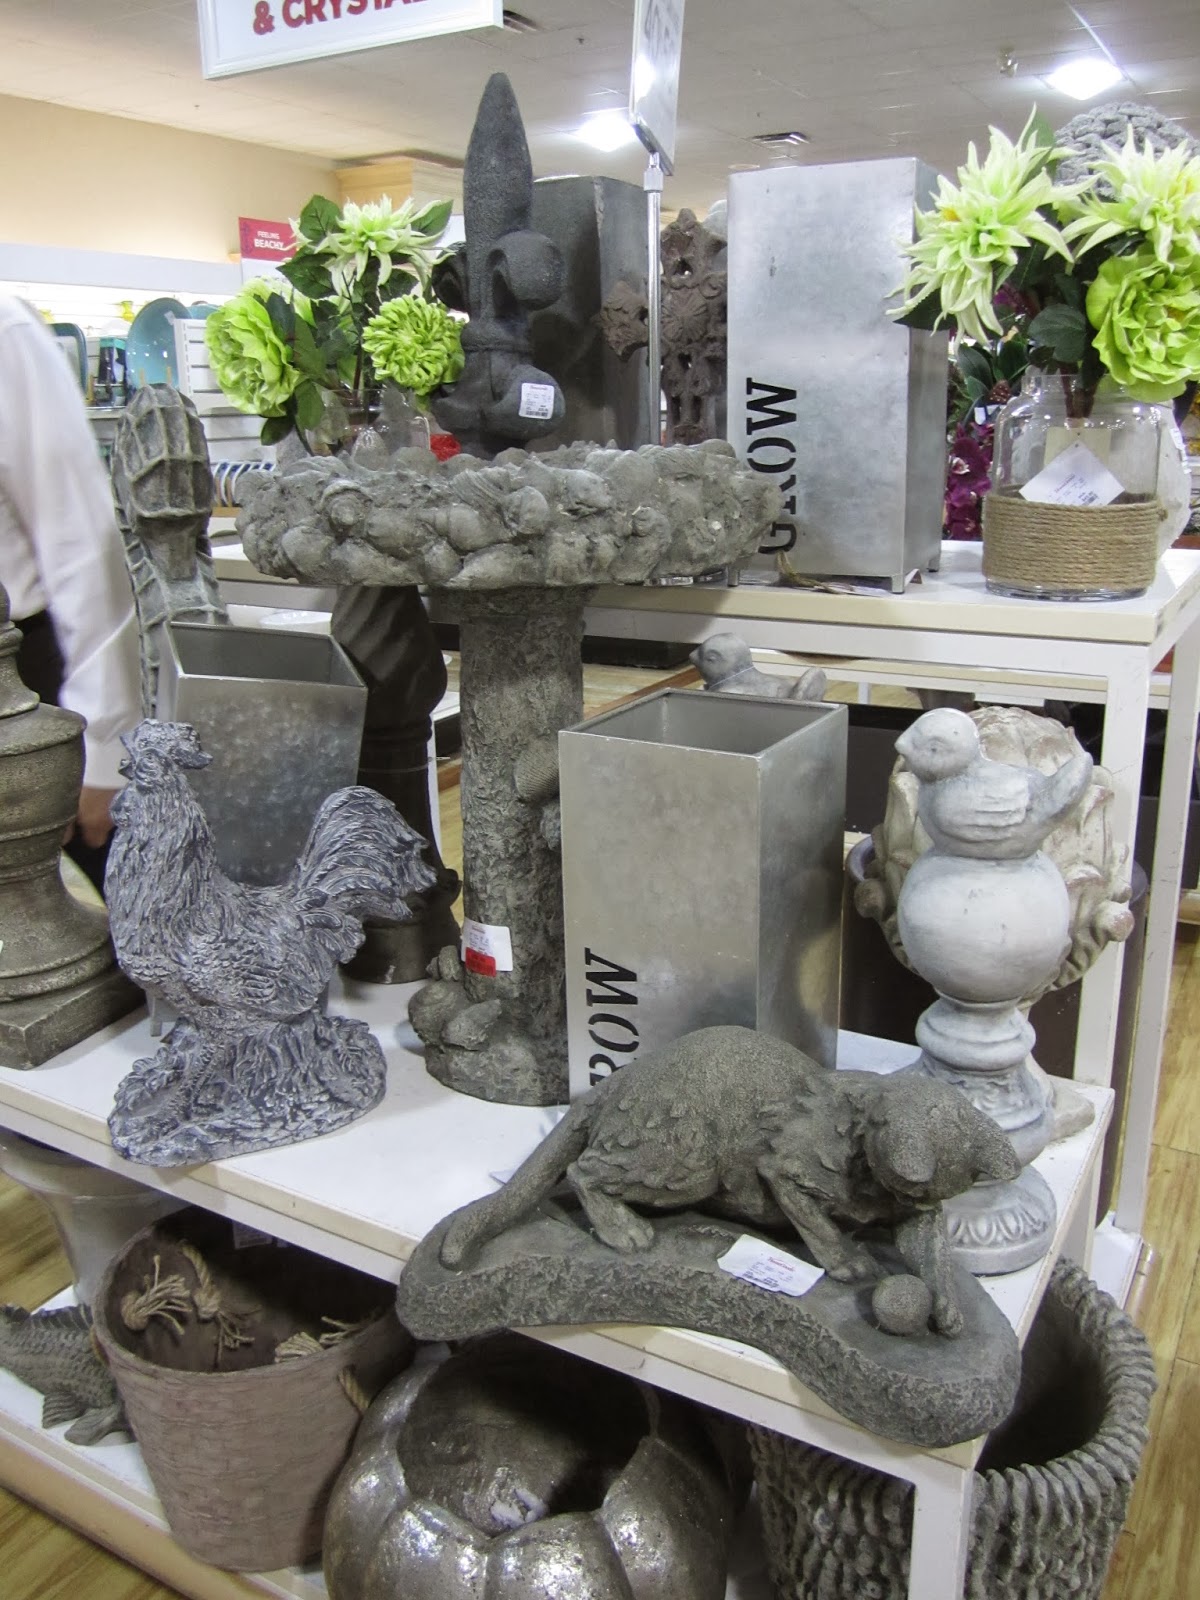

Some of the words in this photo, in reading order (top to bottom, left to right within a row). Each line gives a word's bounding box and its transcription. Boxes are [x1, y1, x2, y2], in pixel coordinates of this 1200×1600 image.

[253, 0, 275, 36] &
[282, 0, 428, 28] CRYS
[253, 238, 284, 250] BEACHY
